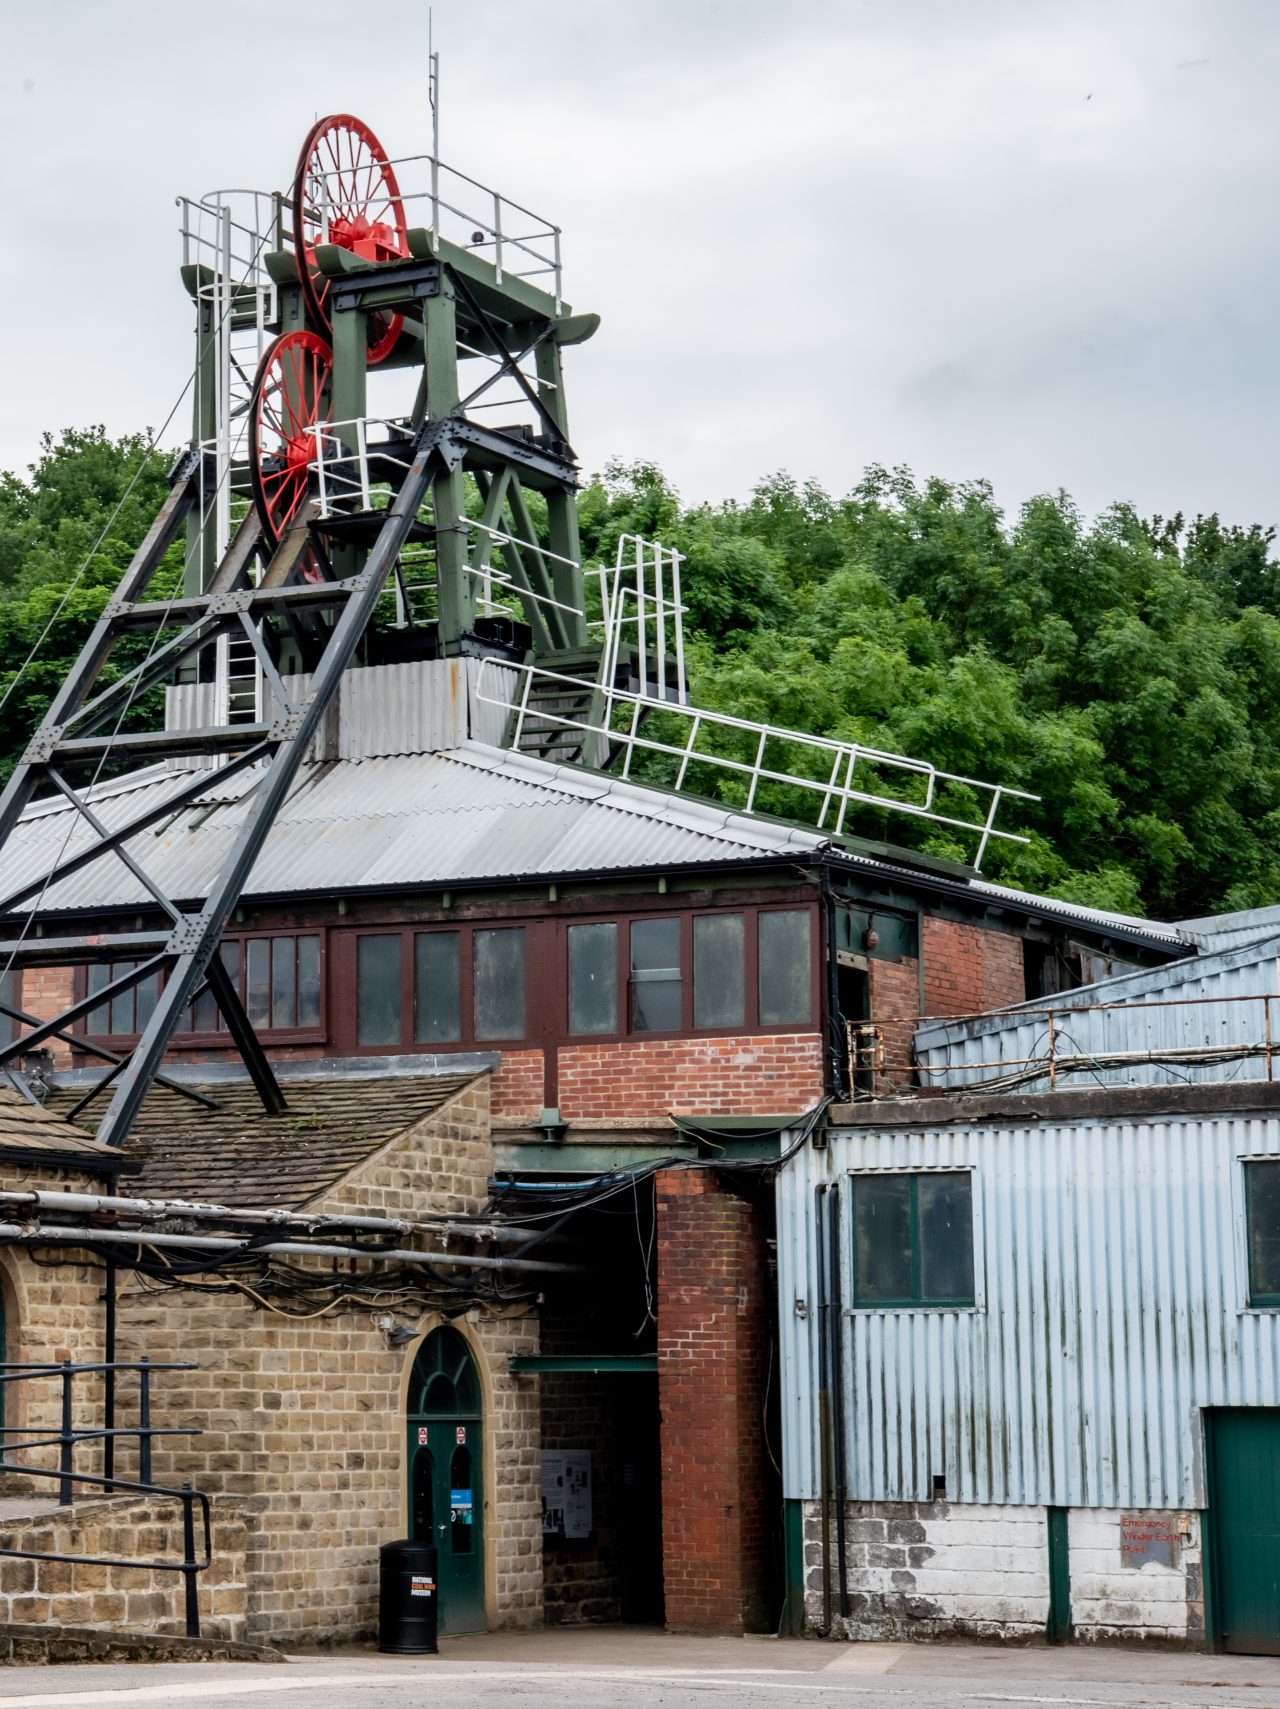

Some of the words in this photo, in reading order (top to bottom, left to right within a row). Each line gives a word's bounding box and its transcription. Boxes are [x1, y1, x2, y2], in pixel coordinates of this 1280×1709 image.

[1123, 1518, 1171, 1529] Emergency
[1123, 1532, 1153, 1541] Winder
[1154, 1532, 1180, 1542] Earth
[1122, 1544, 1145, 1553] Point
